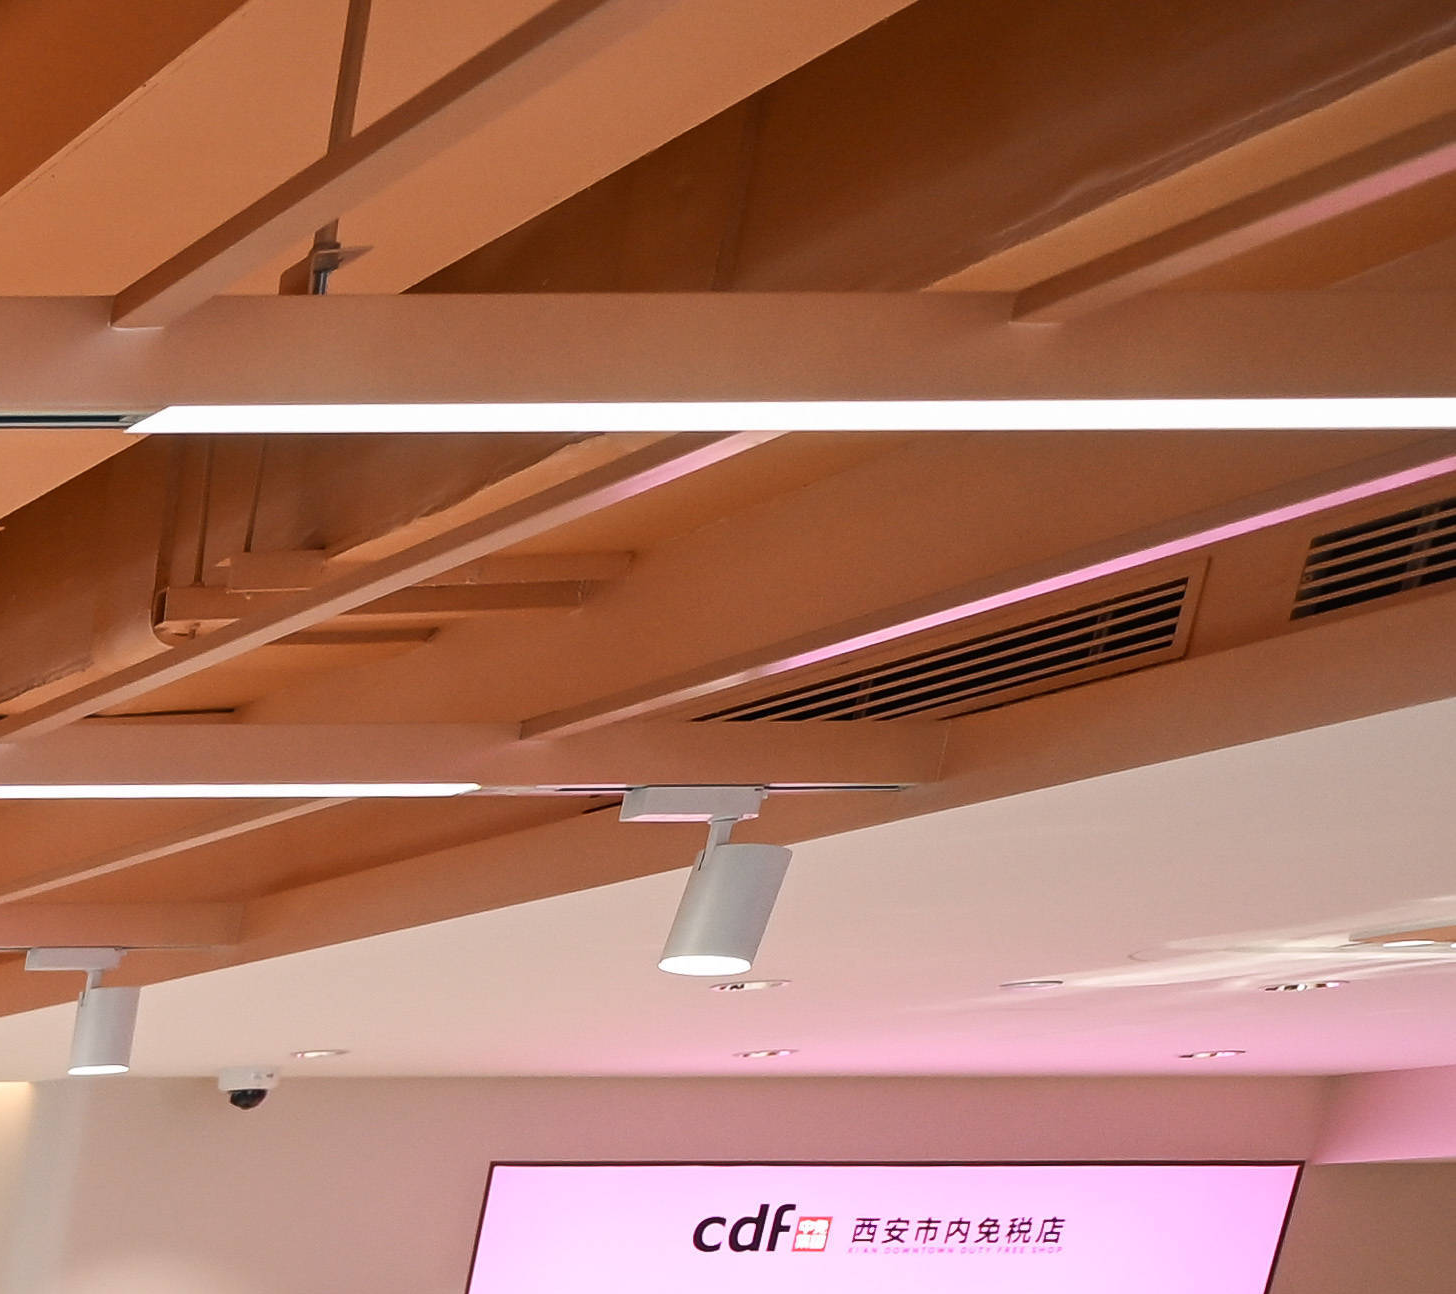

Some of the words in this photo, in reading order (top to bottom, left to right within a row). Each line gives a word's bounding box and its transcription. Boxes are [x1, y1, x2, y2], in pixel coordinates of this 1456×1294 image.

[692, 1203, 797, 1253] cdf
[851, 1216, 1066, 1244] 西安市内免税店
[884, 1246, 954, 1255] DOWNTOWN
[961, 1246, 991, 1255] DUTY
[997, 1246, 1025, 1255] FREE
[1032, 1246, 1063, 1255] SHOP
